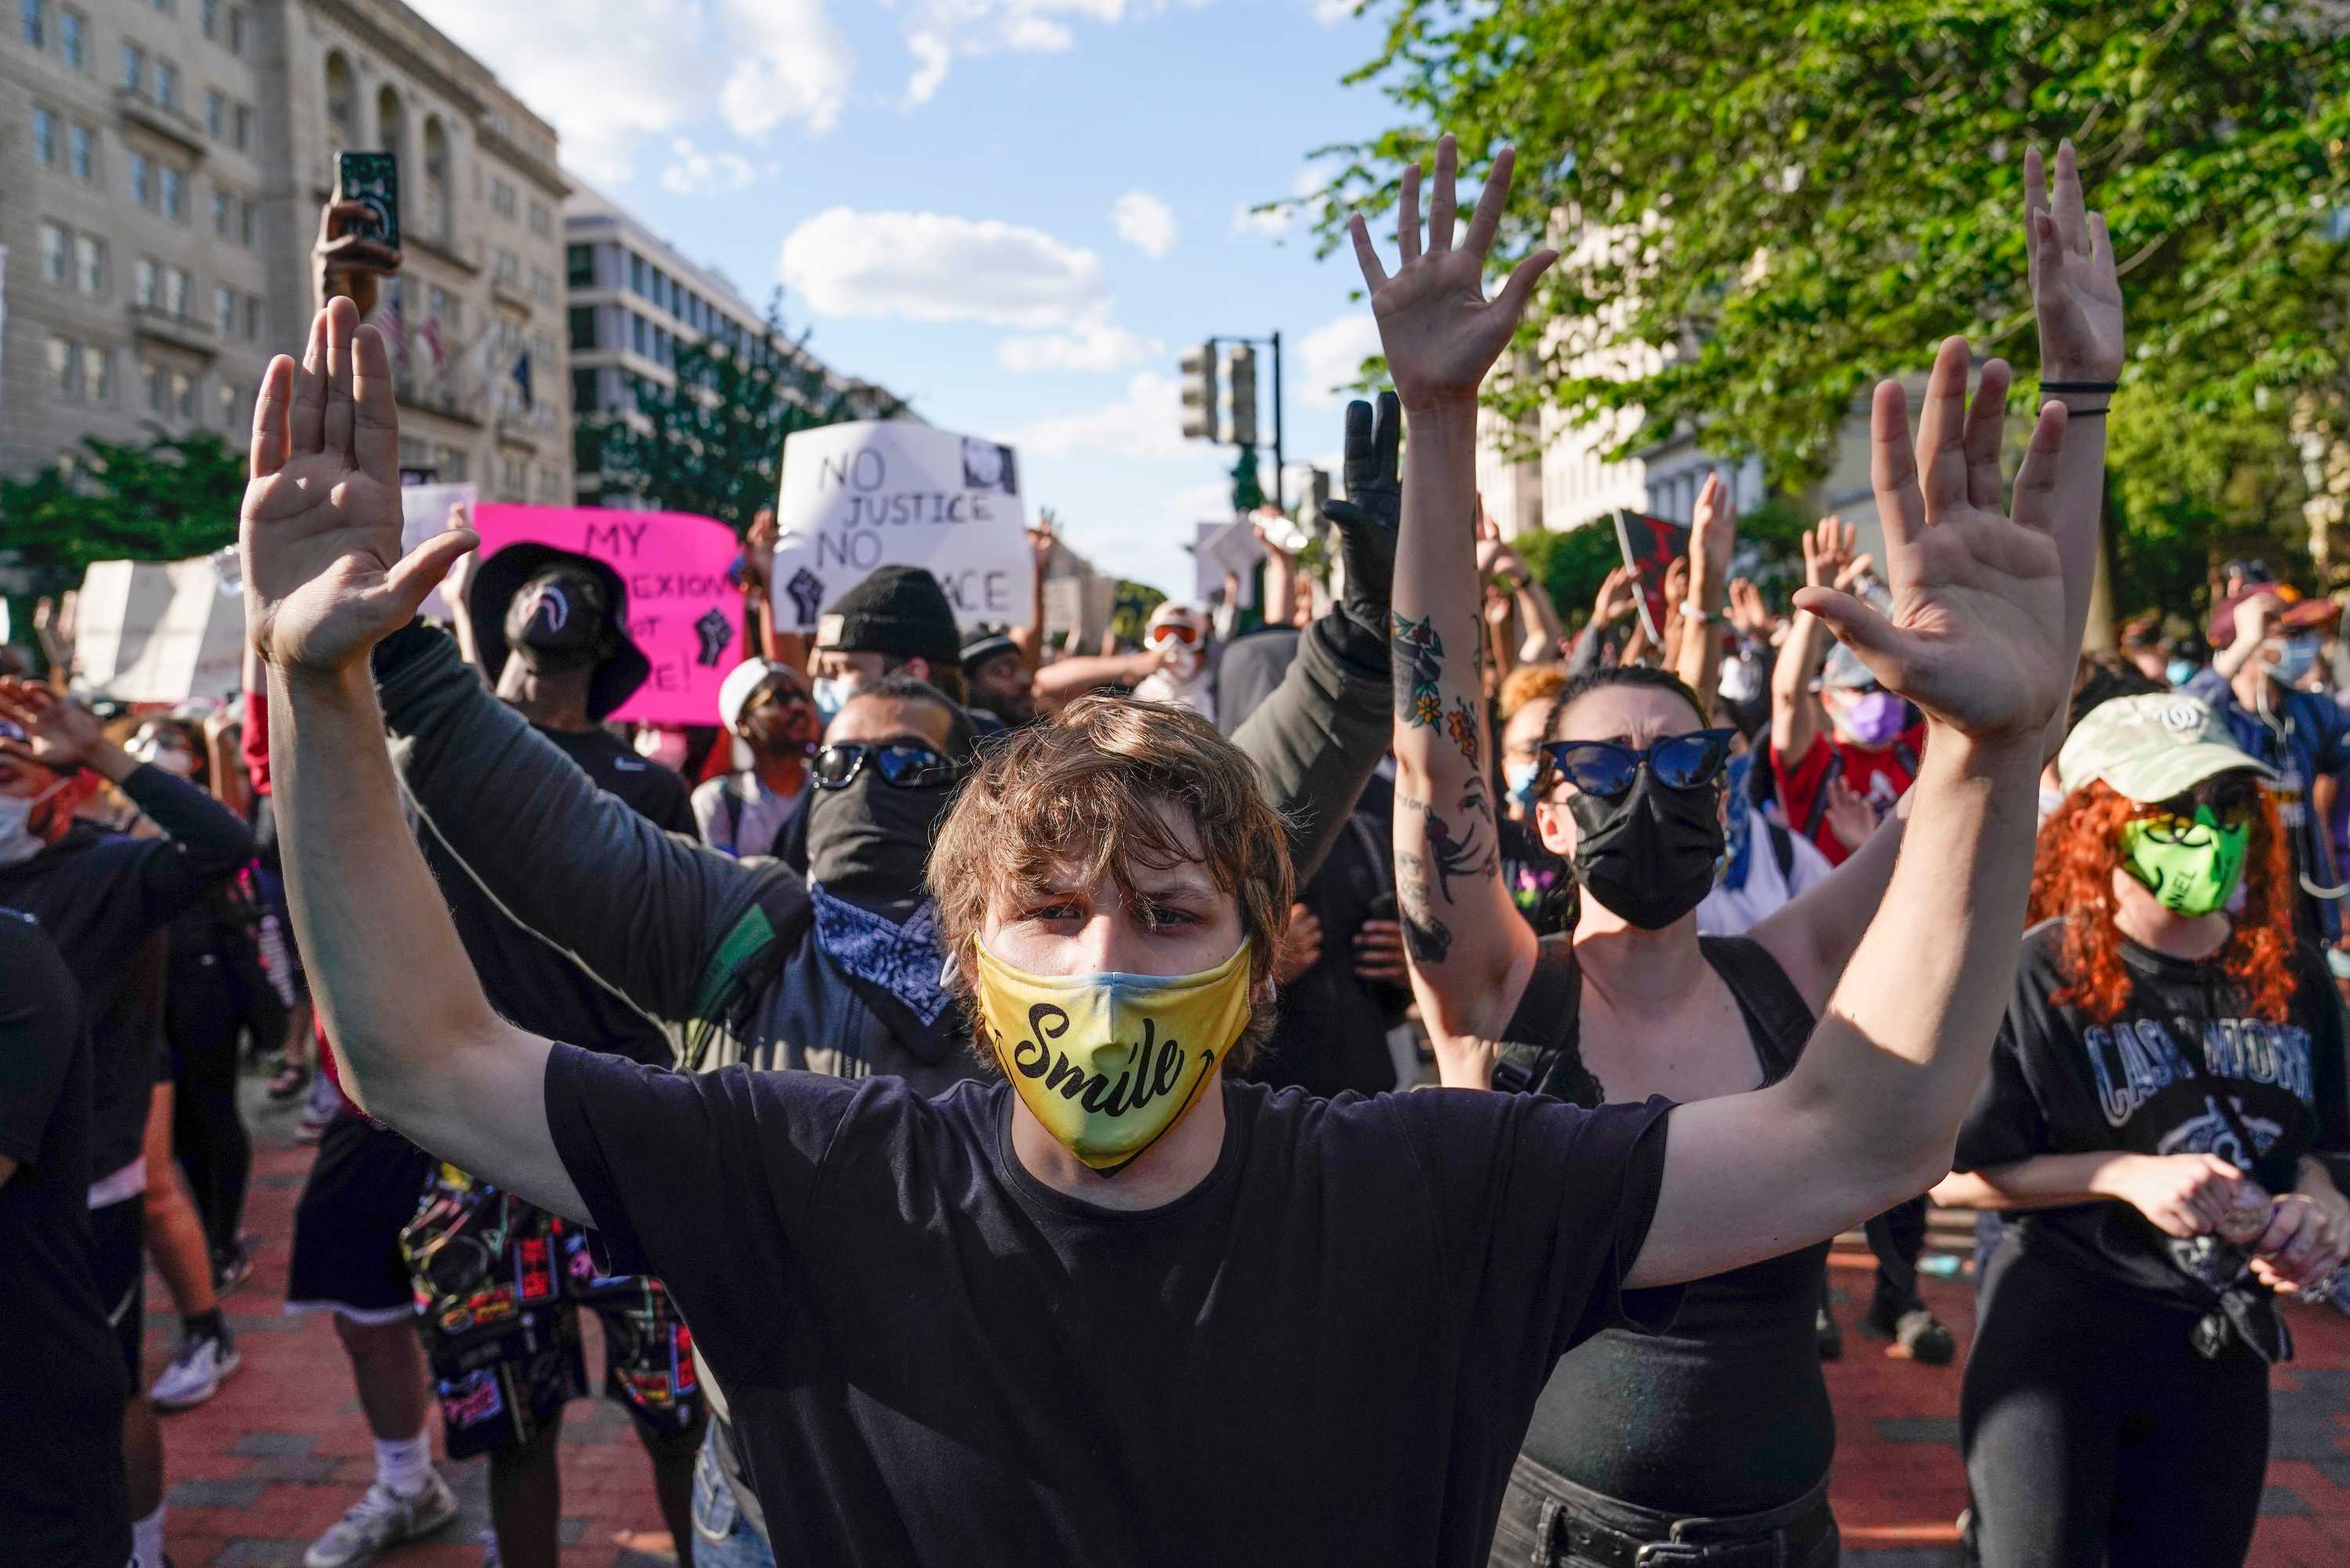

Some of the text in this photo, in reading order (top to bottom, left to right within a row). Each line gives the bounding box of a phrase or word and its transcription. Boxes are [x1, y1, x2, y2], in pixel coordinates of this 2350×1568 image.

[819, 446, 886, 493] NO
[843, 491, 993, 529] JUSTICE
[585, 522, 648, 558] MY
[816, 529, 883, 572] NO
[631, 572, 730, 600] EXION
[1014, 1003, 1184, 1118] Smile
